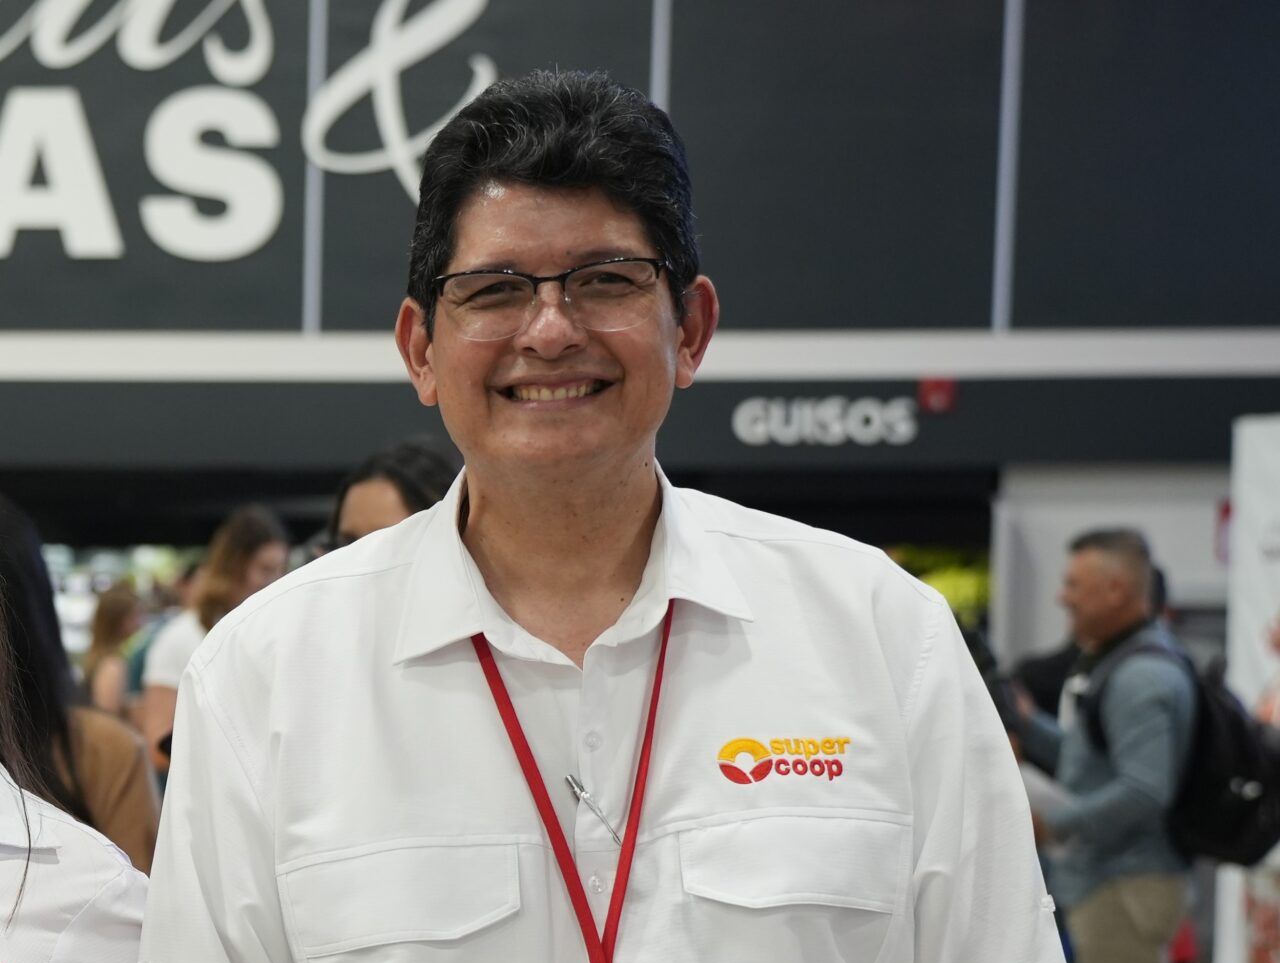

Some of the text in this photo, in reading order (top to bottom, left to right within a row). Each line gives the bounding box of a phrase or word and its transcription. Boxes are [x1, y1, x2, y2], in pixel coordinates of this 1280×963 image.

[732, 396, 918, 446] GUISOS
[770, 737, 851, 760] super
[775, 758, 843, 781] coop
